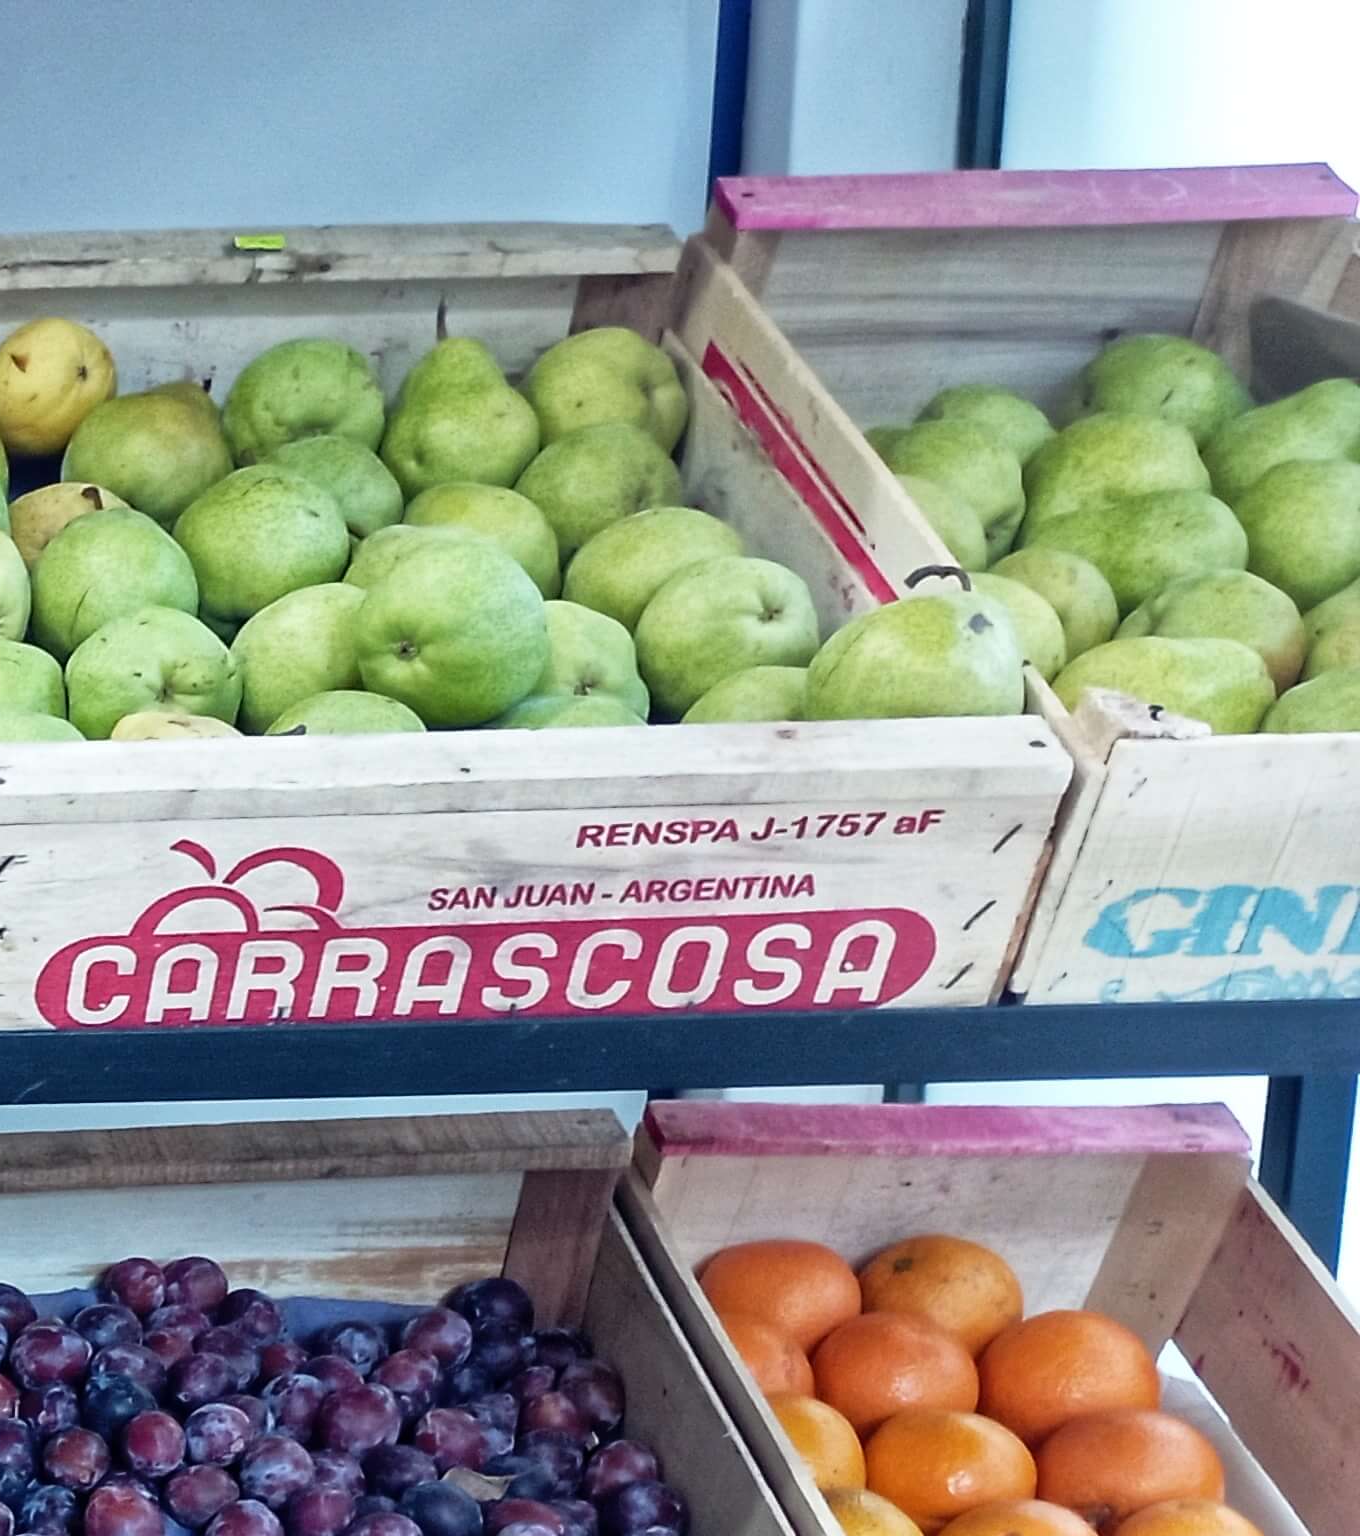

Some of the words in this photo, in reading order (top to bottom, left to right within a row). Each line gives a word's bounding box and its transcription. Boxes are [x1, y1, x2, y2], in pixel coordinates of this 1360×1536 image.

[576, 818, 741, 849] RENSPA
[750, 811, 884, 842] J-1757
[426, 887, 497, 913] SAN
[504, 882, 593, 910] JUAN
[620, 873, 817, 905] ARGENTINA
[67, 918, 898, 1025] CARRASCOSA
